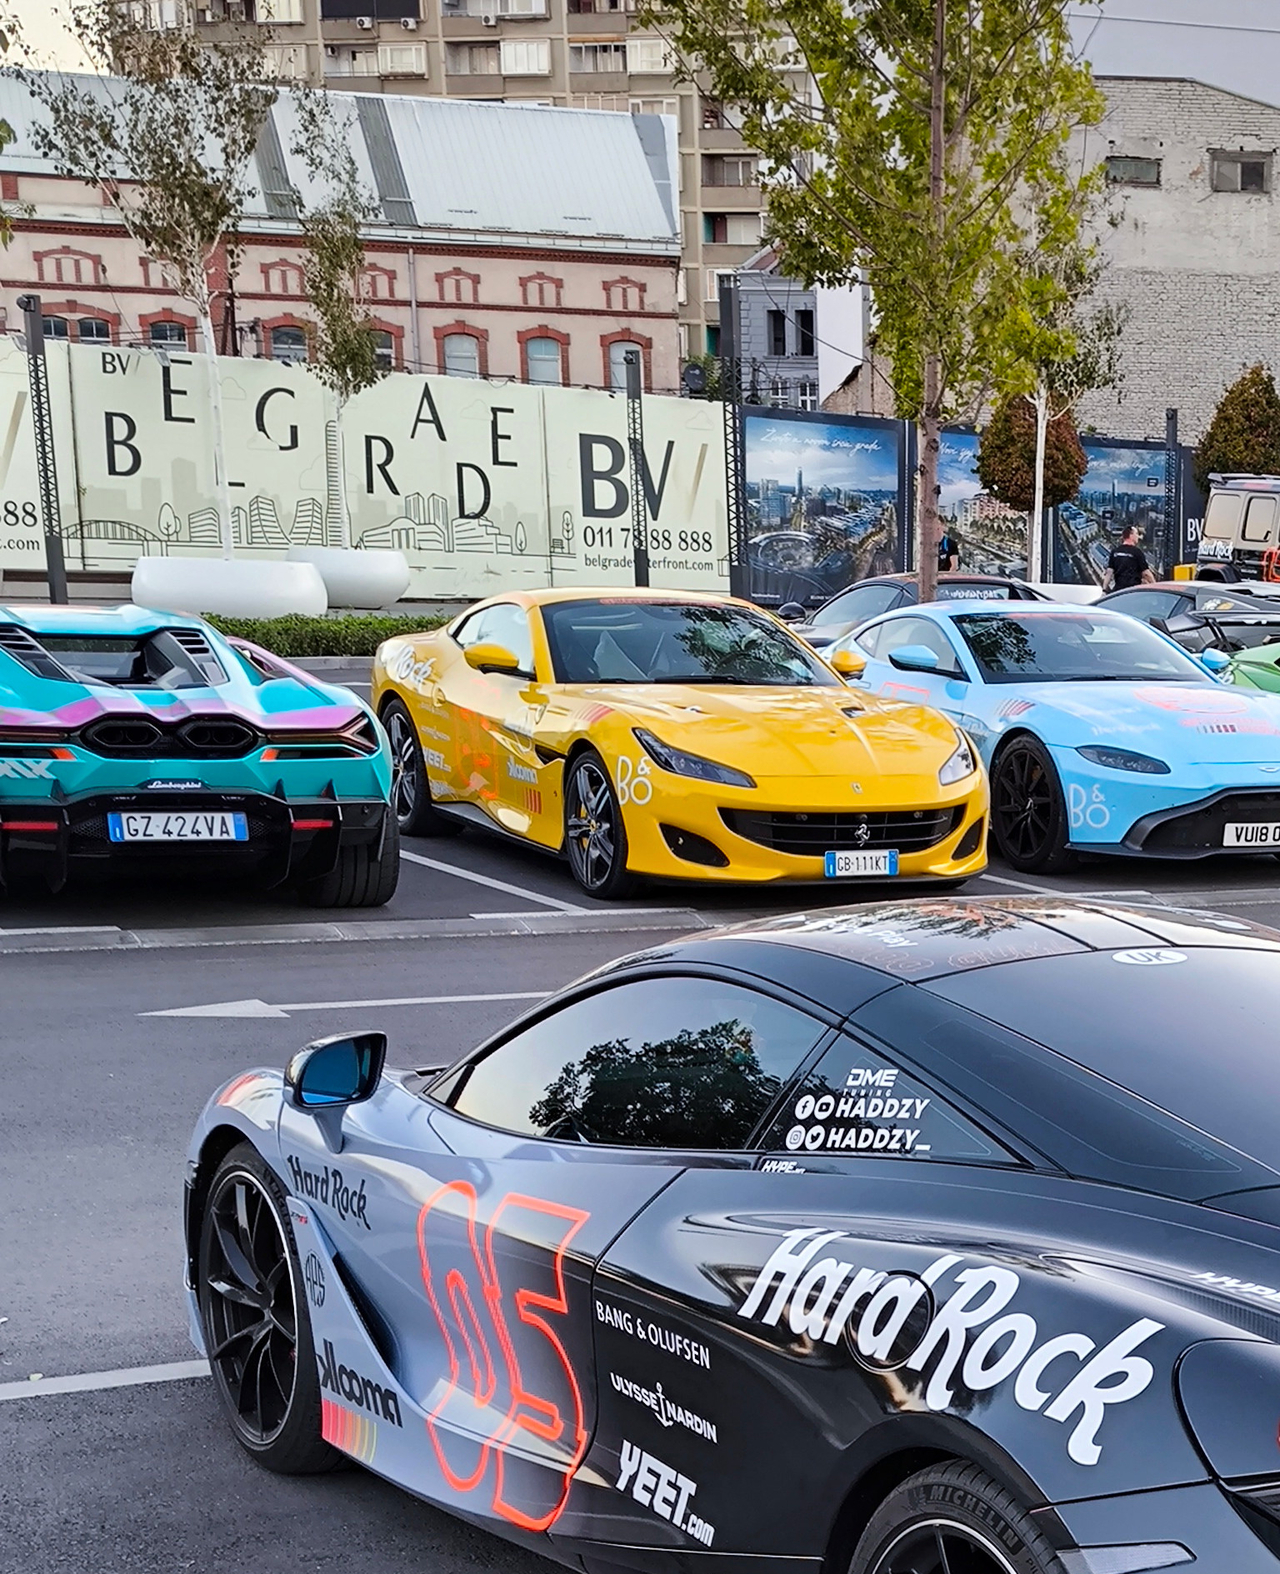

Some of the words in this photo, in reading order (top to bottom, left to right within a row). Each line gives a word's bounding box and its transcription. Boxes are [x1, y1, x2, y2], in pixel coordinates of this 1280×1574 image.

[0, 500, 38, 527] 88
[583, 526, 612, 547] 011
[678, 530, 712, 552] 888
[584, 554, 714, 571] belgradeterfront.com
[126, 816, 154, 838] GZ
[162, 815, 231, 838] 424VA
[1234, 824, 1269, 843] VU18
[837, 857, 854, 873] GB
[856, 855, 888, 872] 111KT
[1126, 950, 1174, 964] UK
[846, 1068, 899, 1087] DME
[842, 1087, 892, 1097] TUNING
[835, 1098, 931, 1119] HADDZY
[287, 1154, 329, 1206] Hard
[331, 1168, 372, 1231] Rock
[596, 1299, 633, 1334] BANG
[636, 1319, 647, 1340] &
[648, 1323, 711, 1370] OLUFSEN
[738, 1227, 963, 1365] Hard
[924, 1264, 1166, 1466] Rock
[610, 1371, 659, 1411] ULYSSE
[666, 1399, 718, 1444] NARDIN
[615, 1438, 716, 1548] YEET.com
[929, 1484, 1020, 1548] MICHELIN
